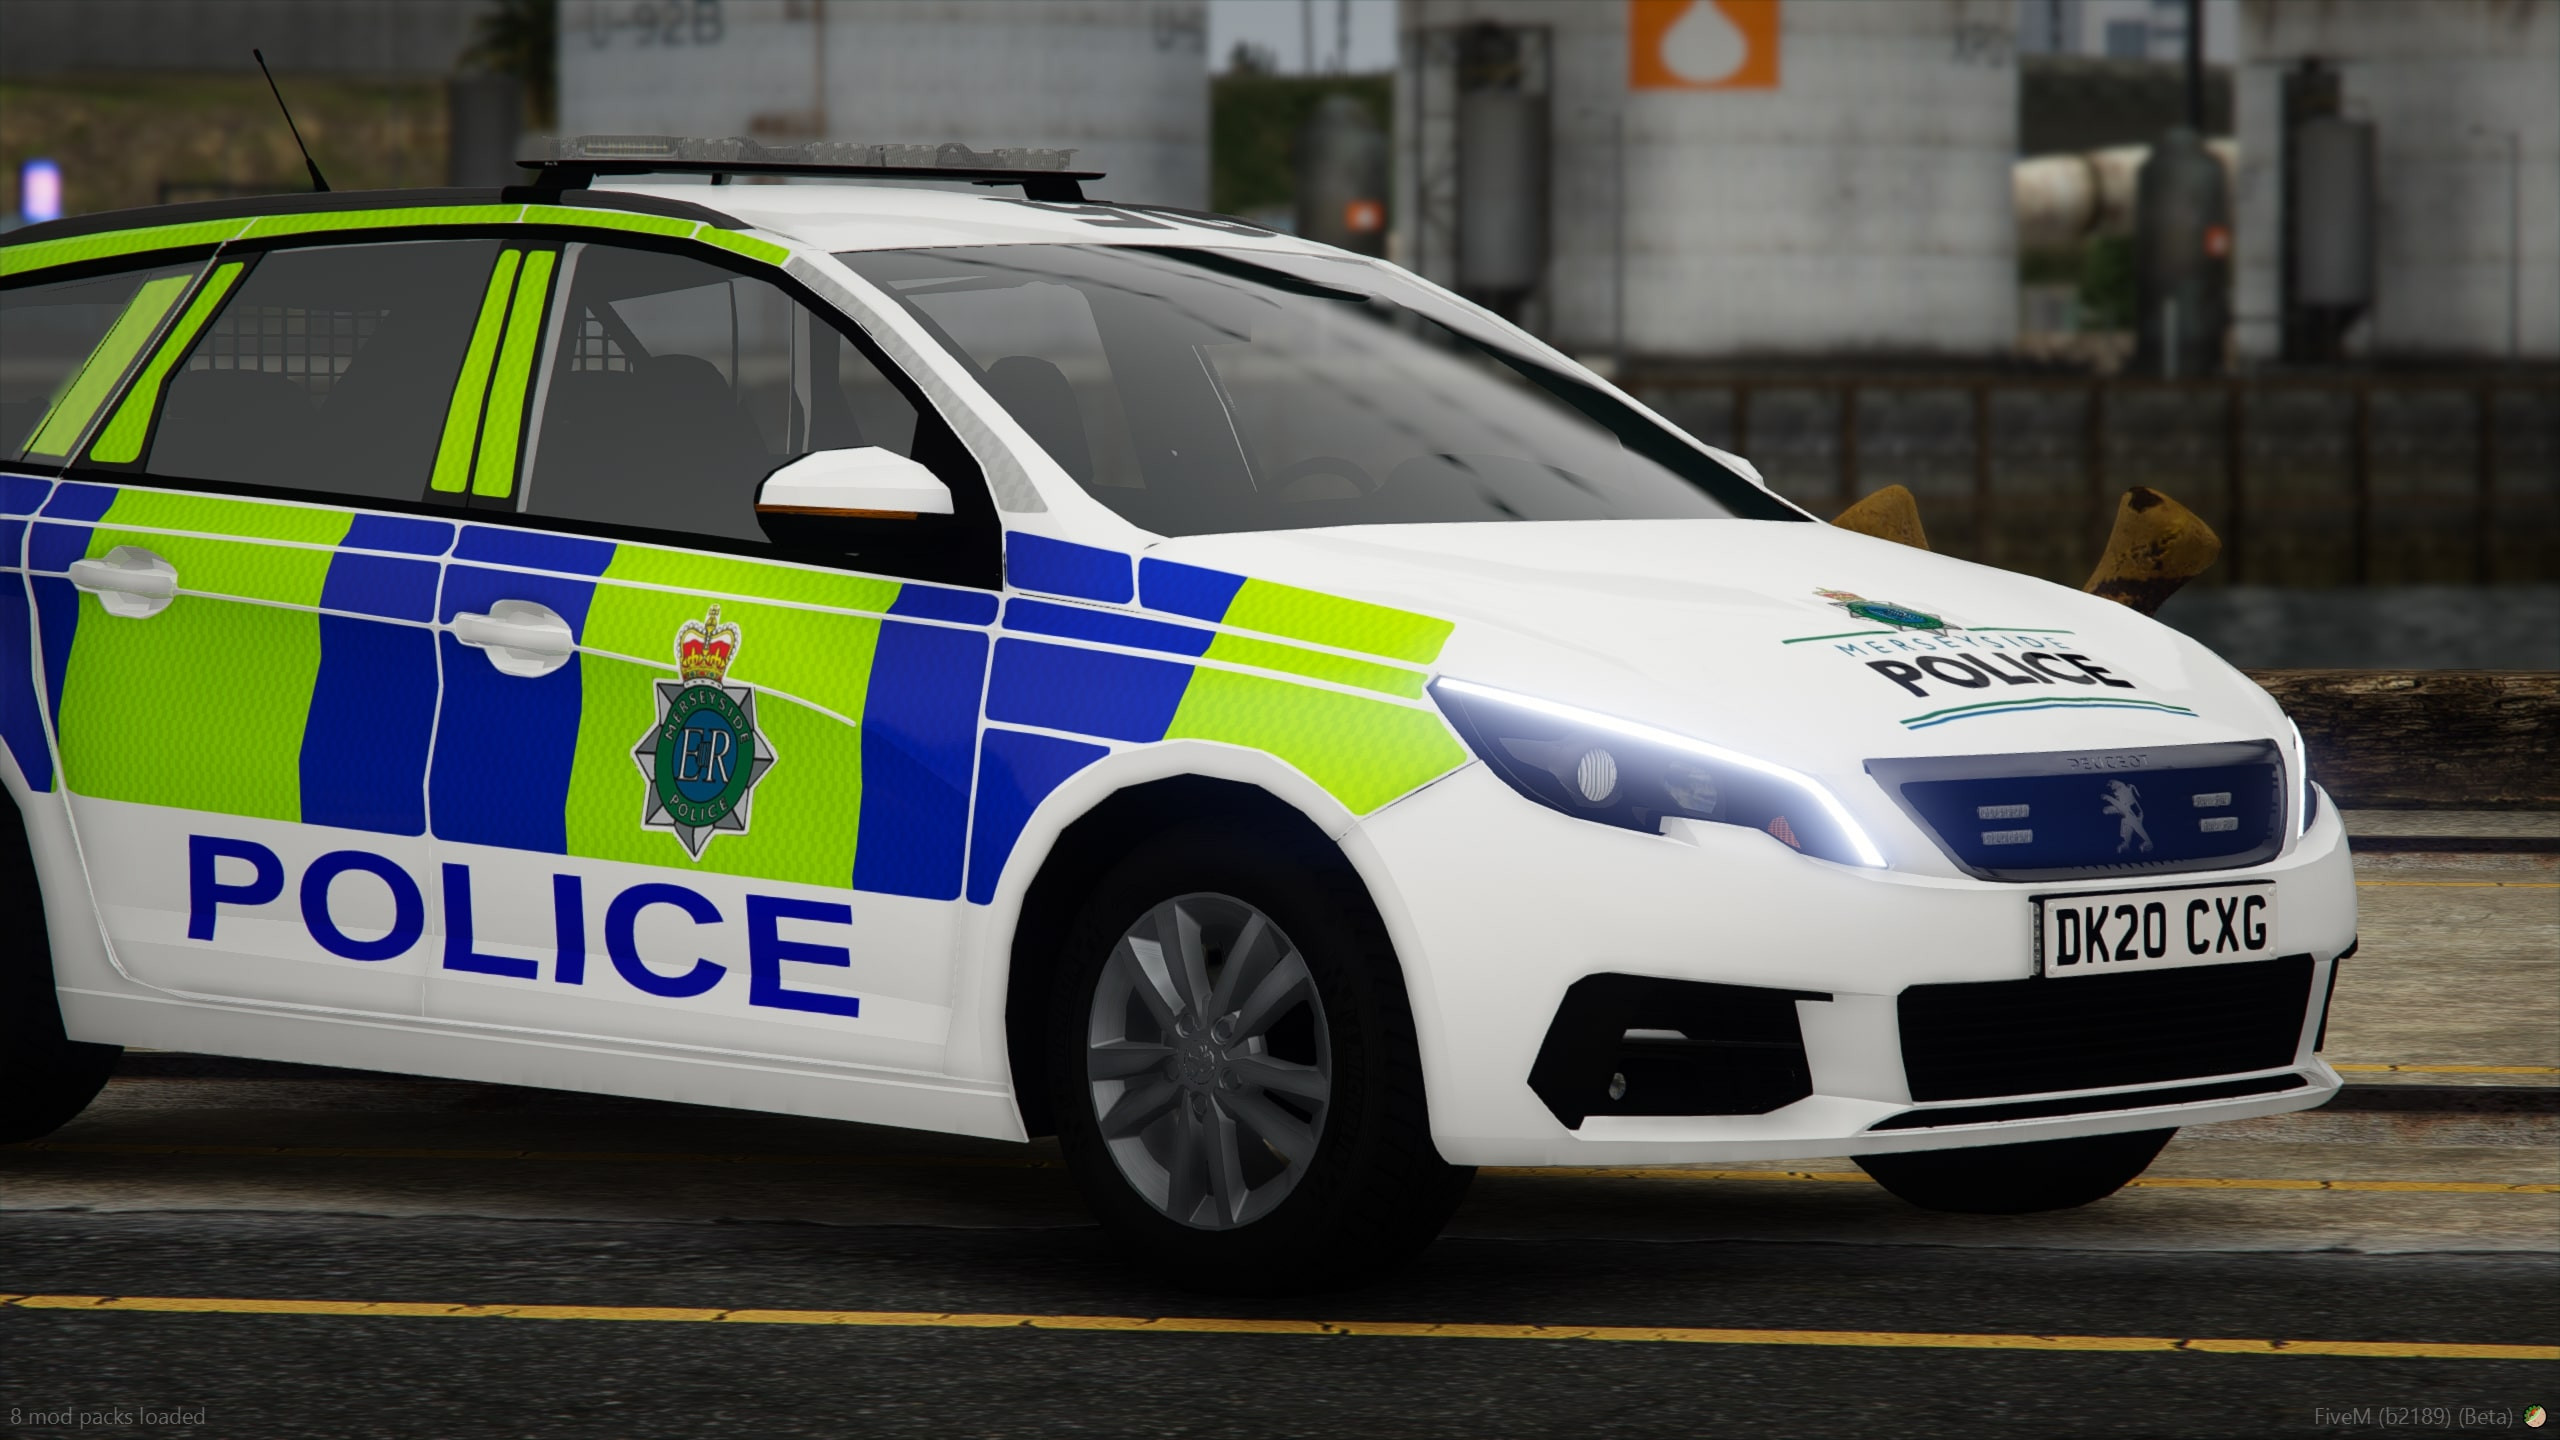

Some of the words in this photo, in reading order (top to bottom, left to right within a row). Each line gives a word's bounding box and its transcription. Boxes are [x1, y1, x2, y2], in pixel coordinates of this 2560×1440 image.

[1834, 635, 2072, 657] MERSEYSIDE
[1865, 651, 2136, 697] POLICE
[665, 691, 750, 743] MERSEYSIDE
[670, 794, 728, 821] POLICE
[188, 834, 860, 1018] POLICE
[2056, 902, 2166, 966] DK20
[2186, 895, 2266, 955] CXG
